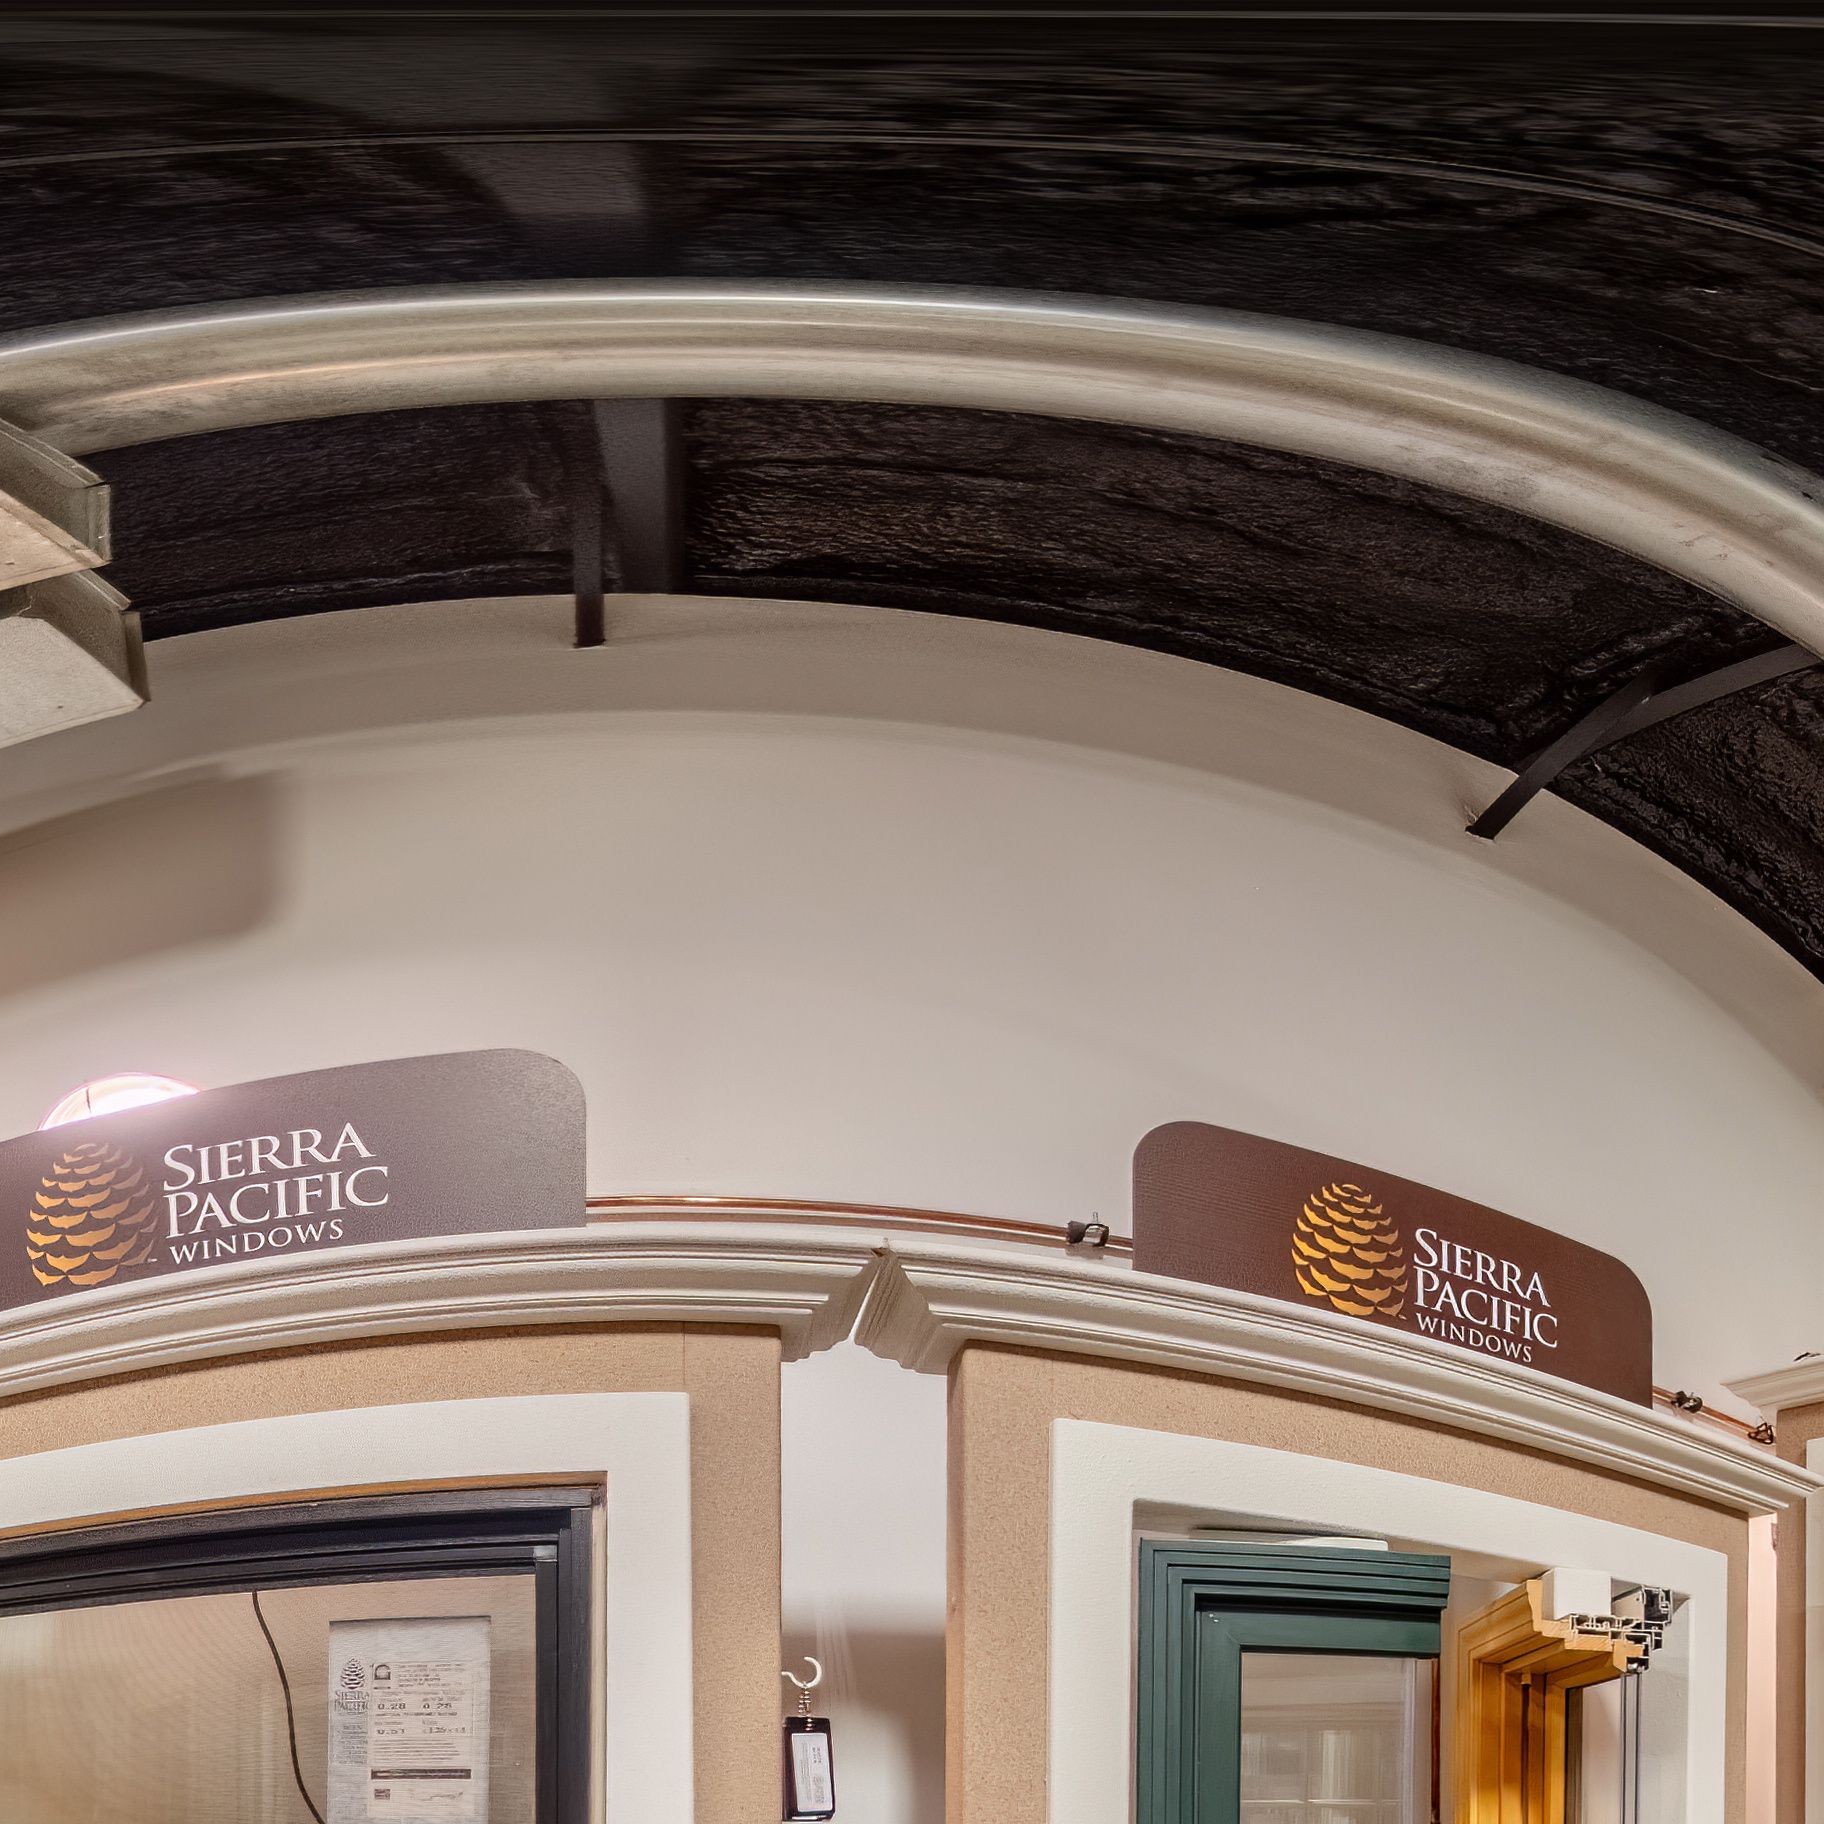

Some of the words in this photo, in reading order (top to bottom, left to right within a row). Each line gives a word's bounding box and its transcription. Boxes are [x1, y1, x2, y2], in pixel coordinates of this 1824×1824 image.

[162, 1121, 377, 1191] SIERRA
[166, 1166, 390, 1238] PACIFIC
[169, 1219, 345, 1266] WINDOWS
[1413, 1228, 1551, 1307] SIERRA
[1414, 1266, 1558, 1348] PACIFIC
[1416, 1313, 1532, 1363] WINDOWS
